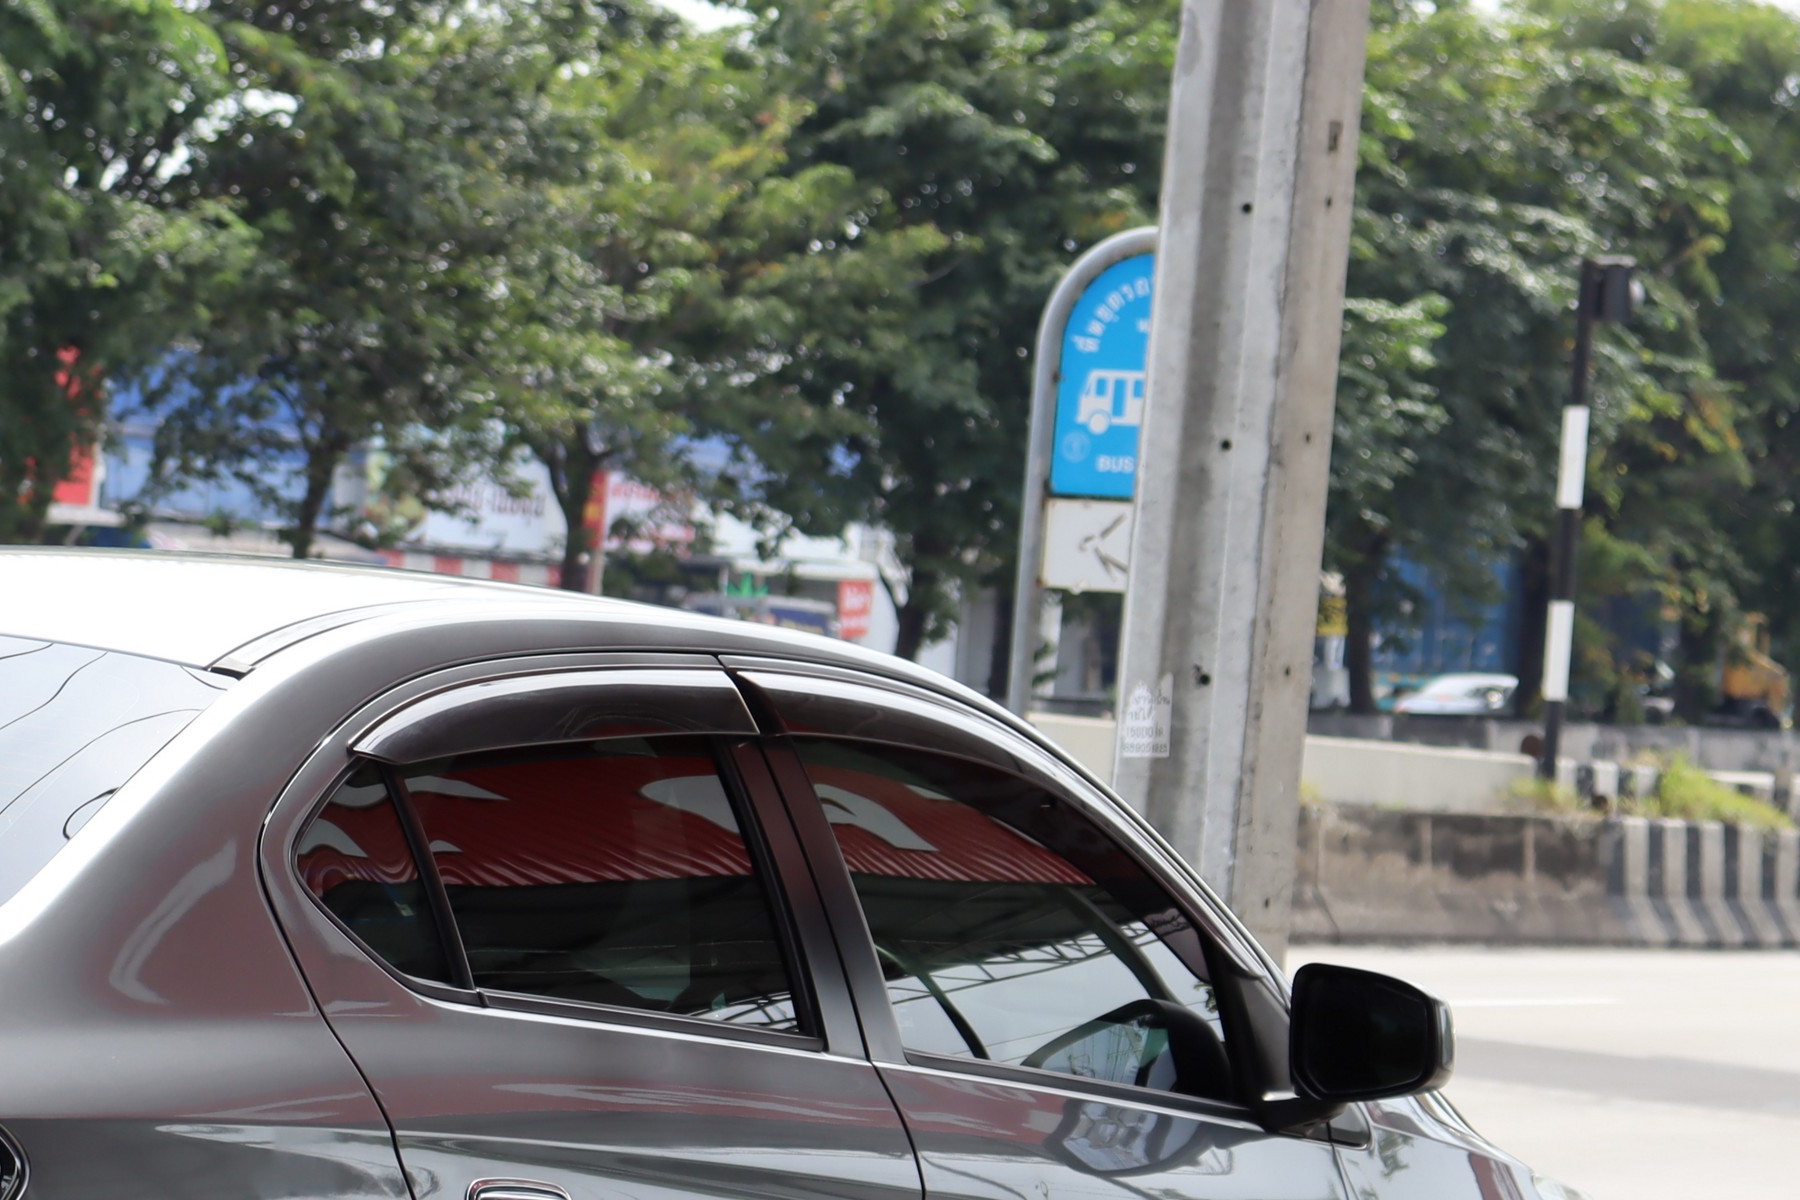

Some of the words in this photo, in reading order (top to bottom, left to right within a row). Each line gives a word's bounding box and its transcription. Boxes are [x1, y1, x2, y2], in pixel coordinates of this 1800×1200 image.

[1072, 276, 1152, 353] ที่หยุดรถ
[1096, 454, 1135, 474] BUS
